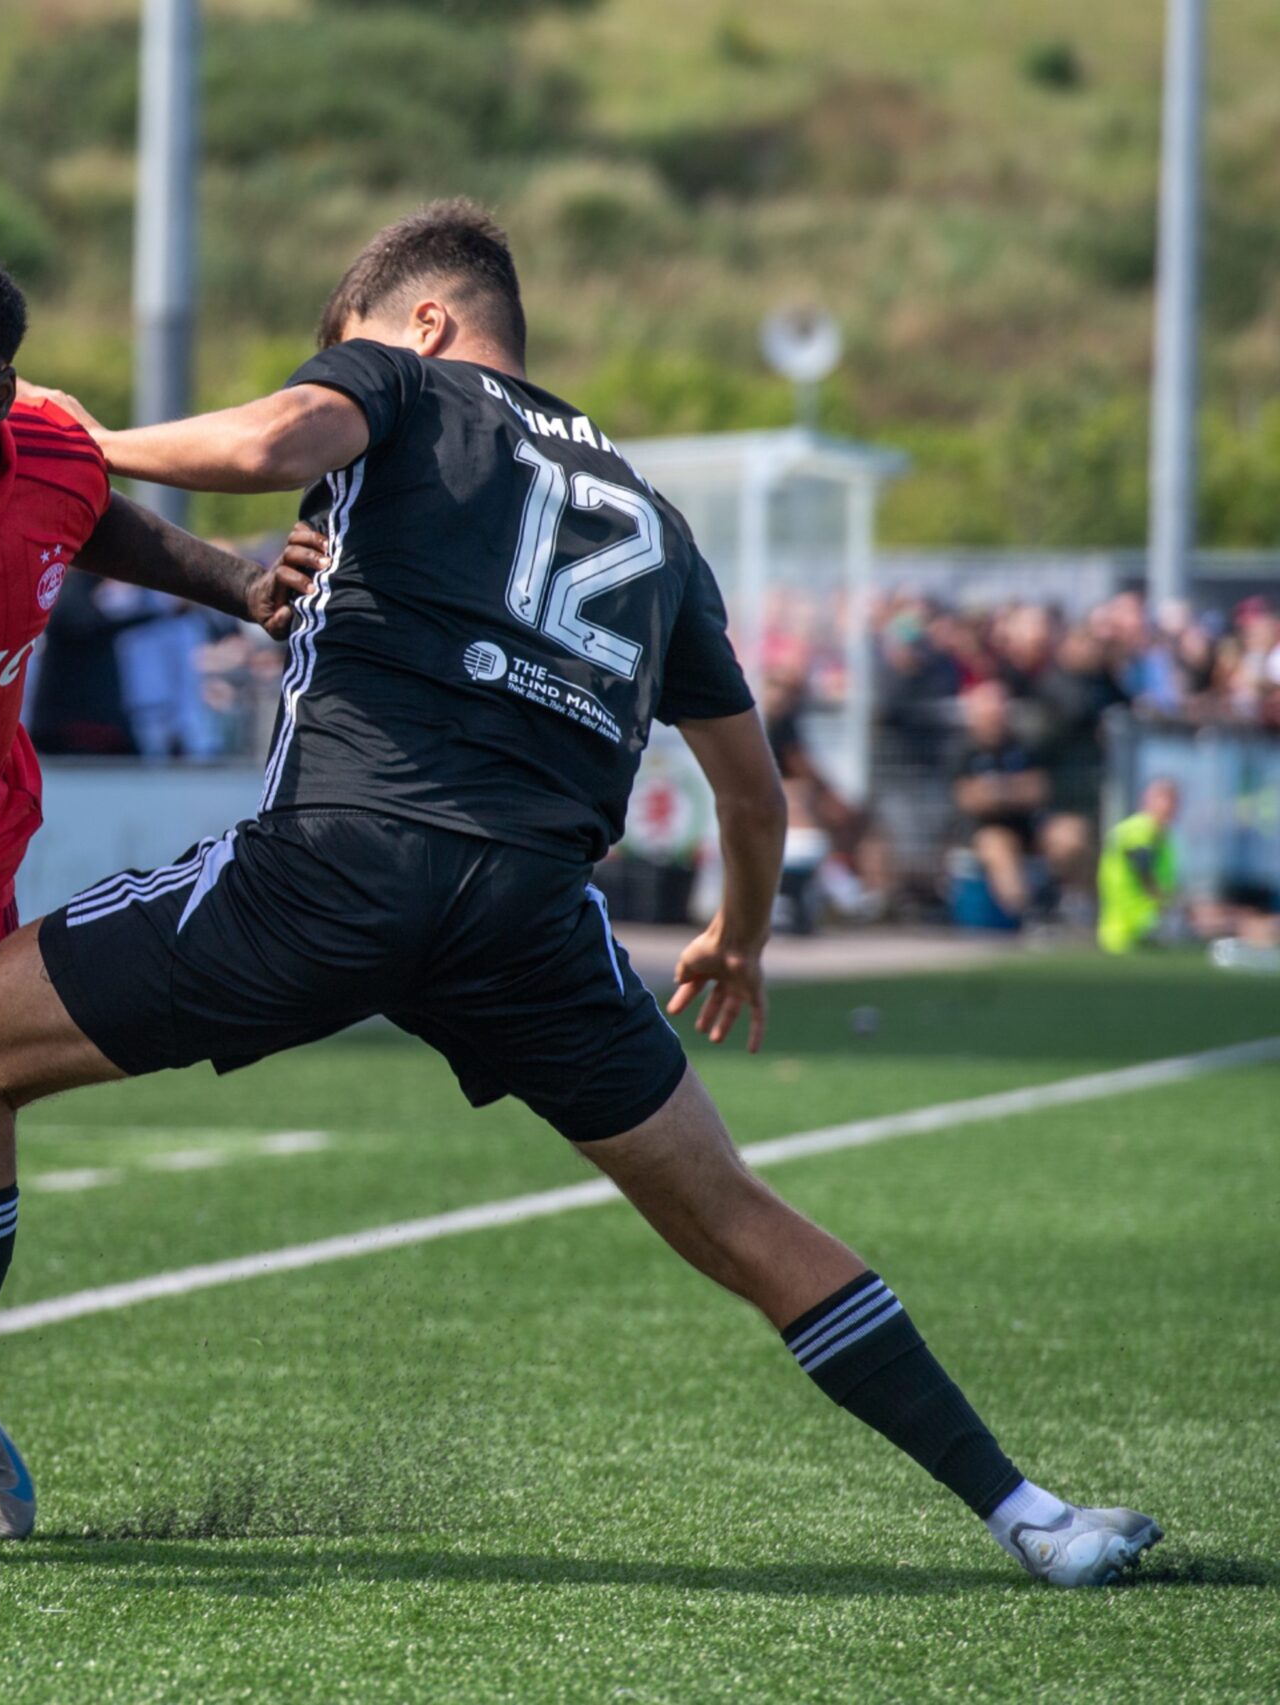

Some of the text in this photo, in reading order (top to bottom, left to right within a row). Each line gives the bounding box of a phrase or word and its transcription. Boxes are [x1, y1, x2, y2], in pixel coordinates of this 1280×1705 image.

[505, 438, 665, 680] 12
[513, 657, 548, 681] THE
[507, 672, 559, 698] BLIND
